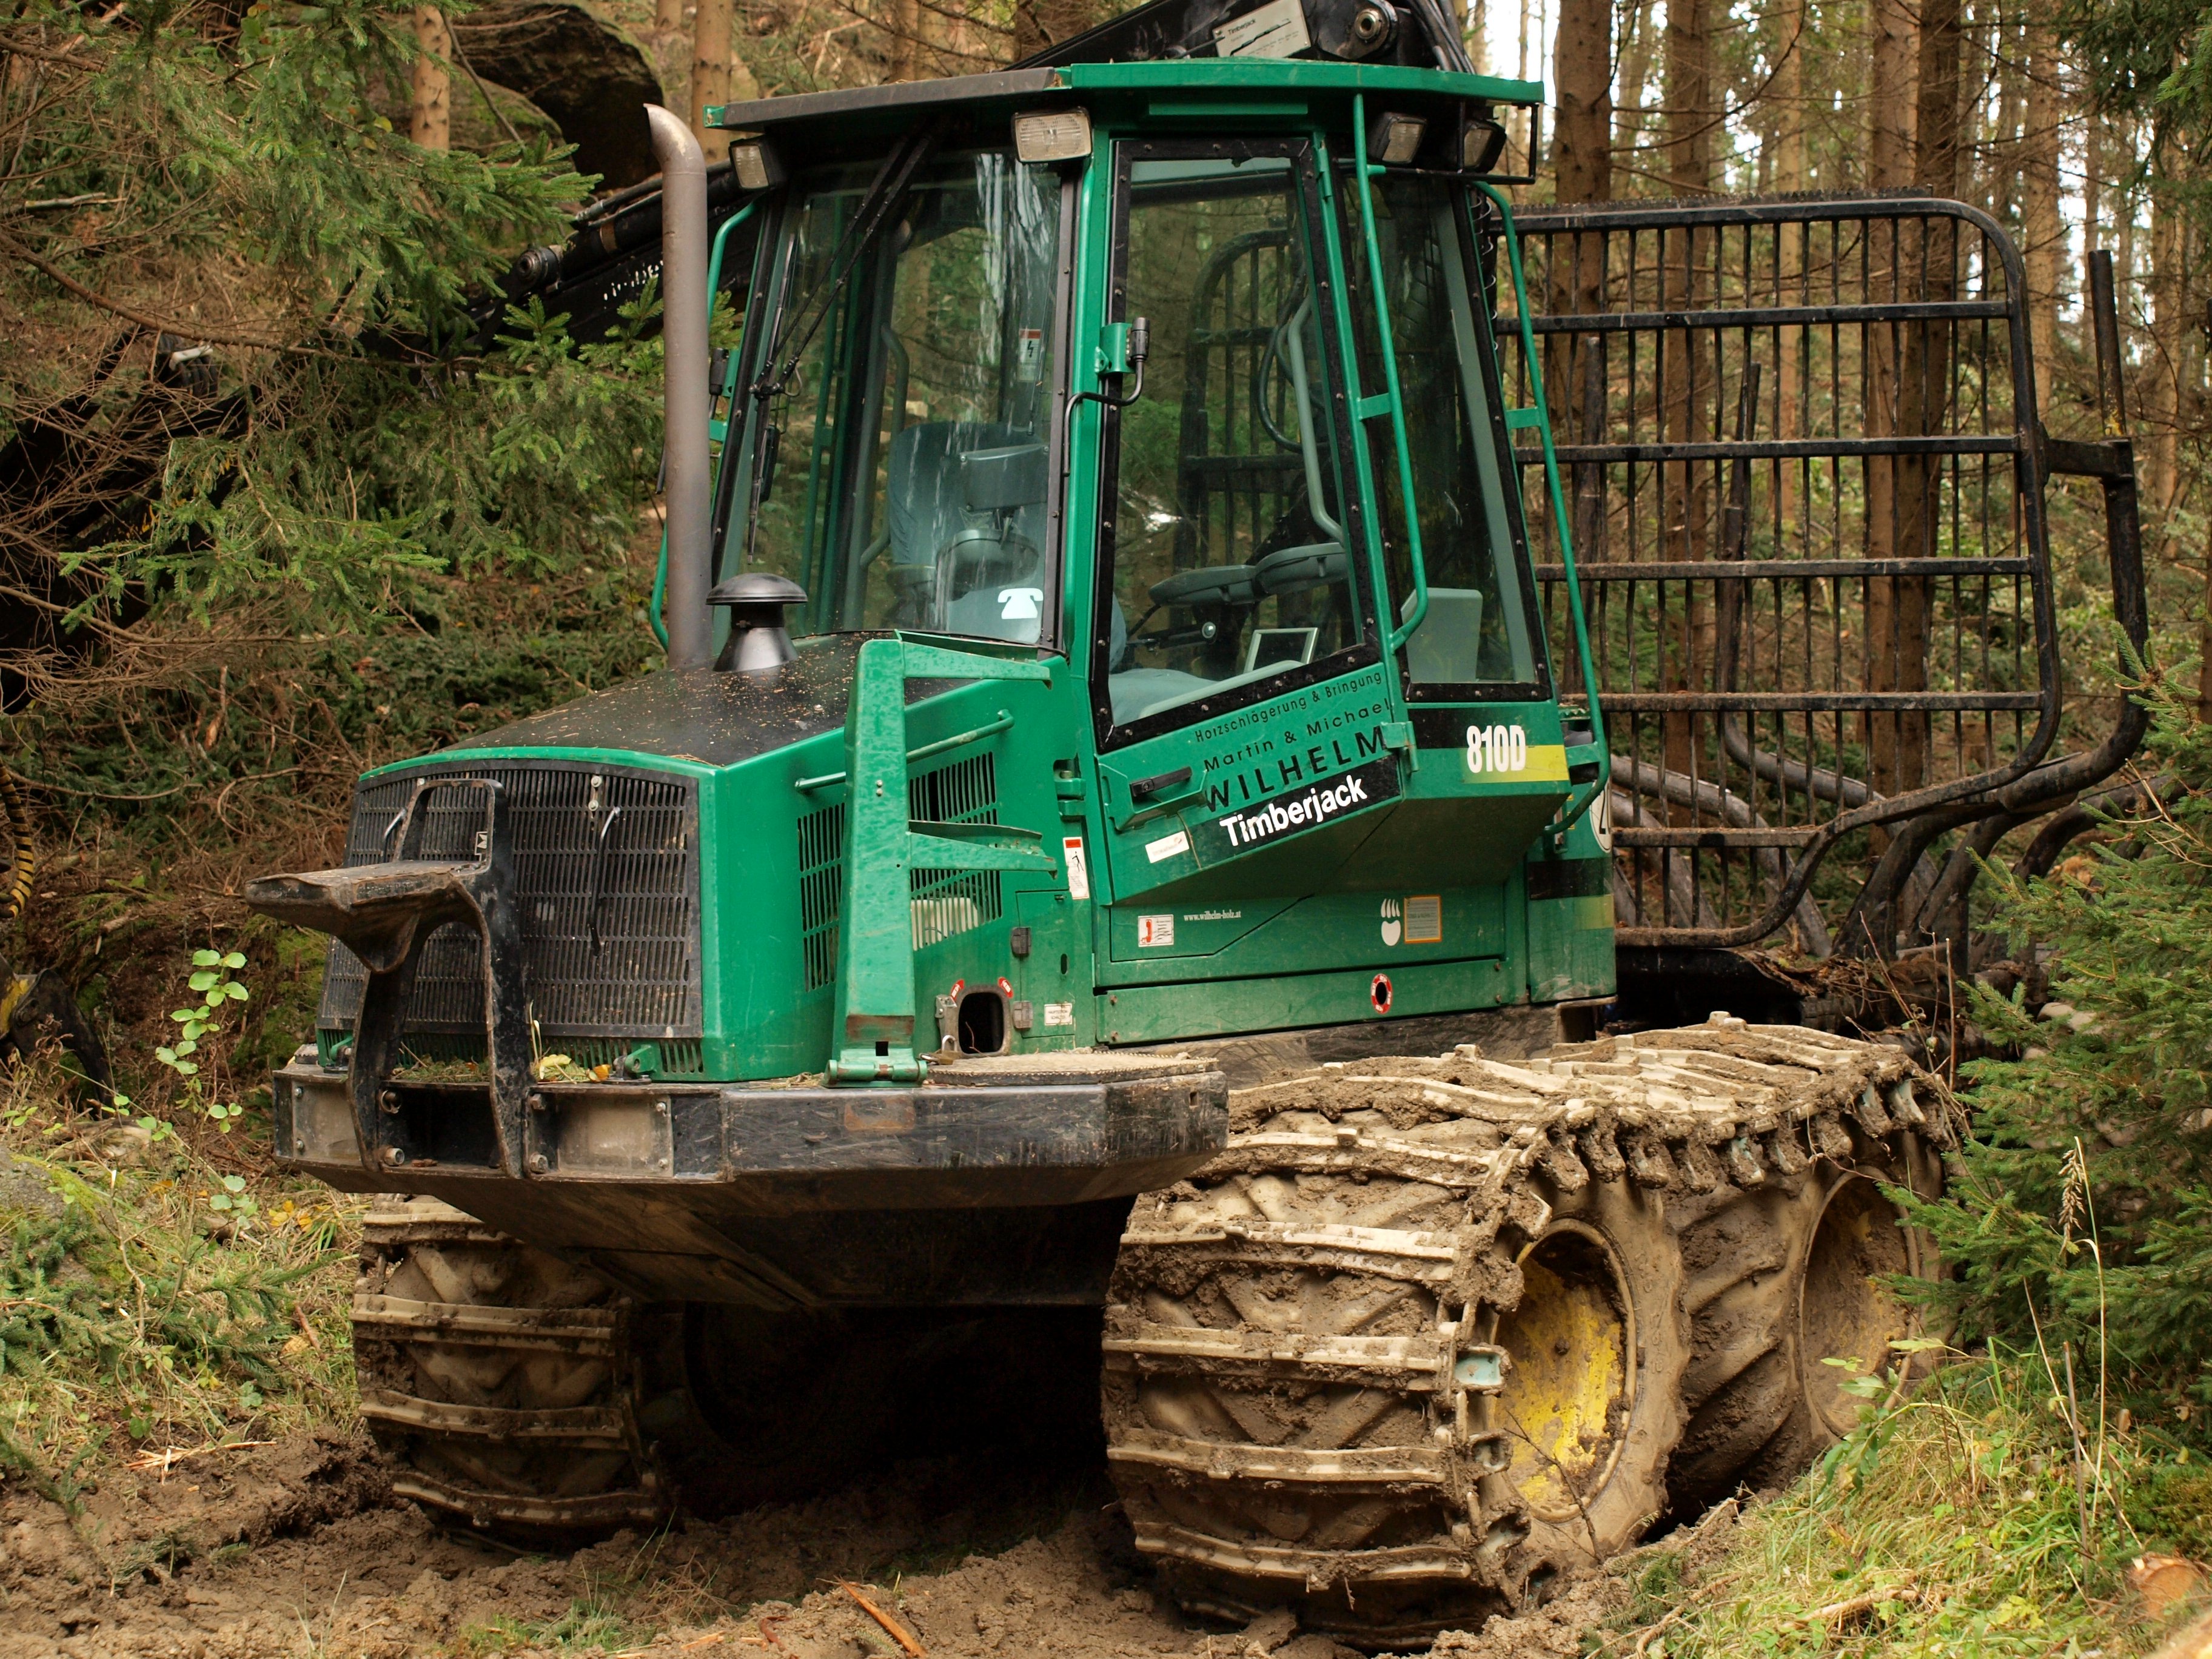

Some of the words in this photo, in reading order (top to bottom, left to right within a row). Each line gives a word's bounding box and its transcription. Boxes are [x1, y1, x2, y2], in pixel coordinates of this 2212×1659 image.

[1312, 690, 1321, 703] &
[1325, 671, 1382, 699] Bringung
[1204, 740, 1274, 772] Martin
[1284, 731, 1297, 744] &
[1307, 698, 1389, 737] Michael
[1466, 725, 1526, 774] 810D
[1205, 725, 1387, 813] WILHELM
[1219, 774, 1368, 847] Timberjack
[1183, 909, 1242, 922] www.wilhelm-holz.at
